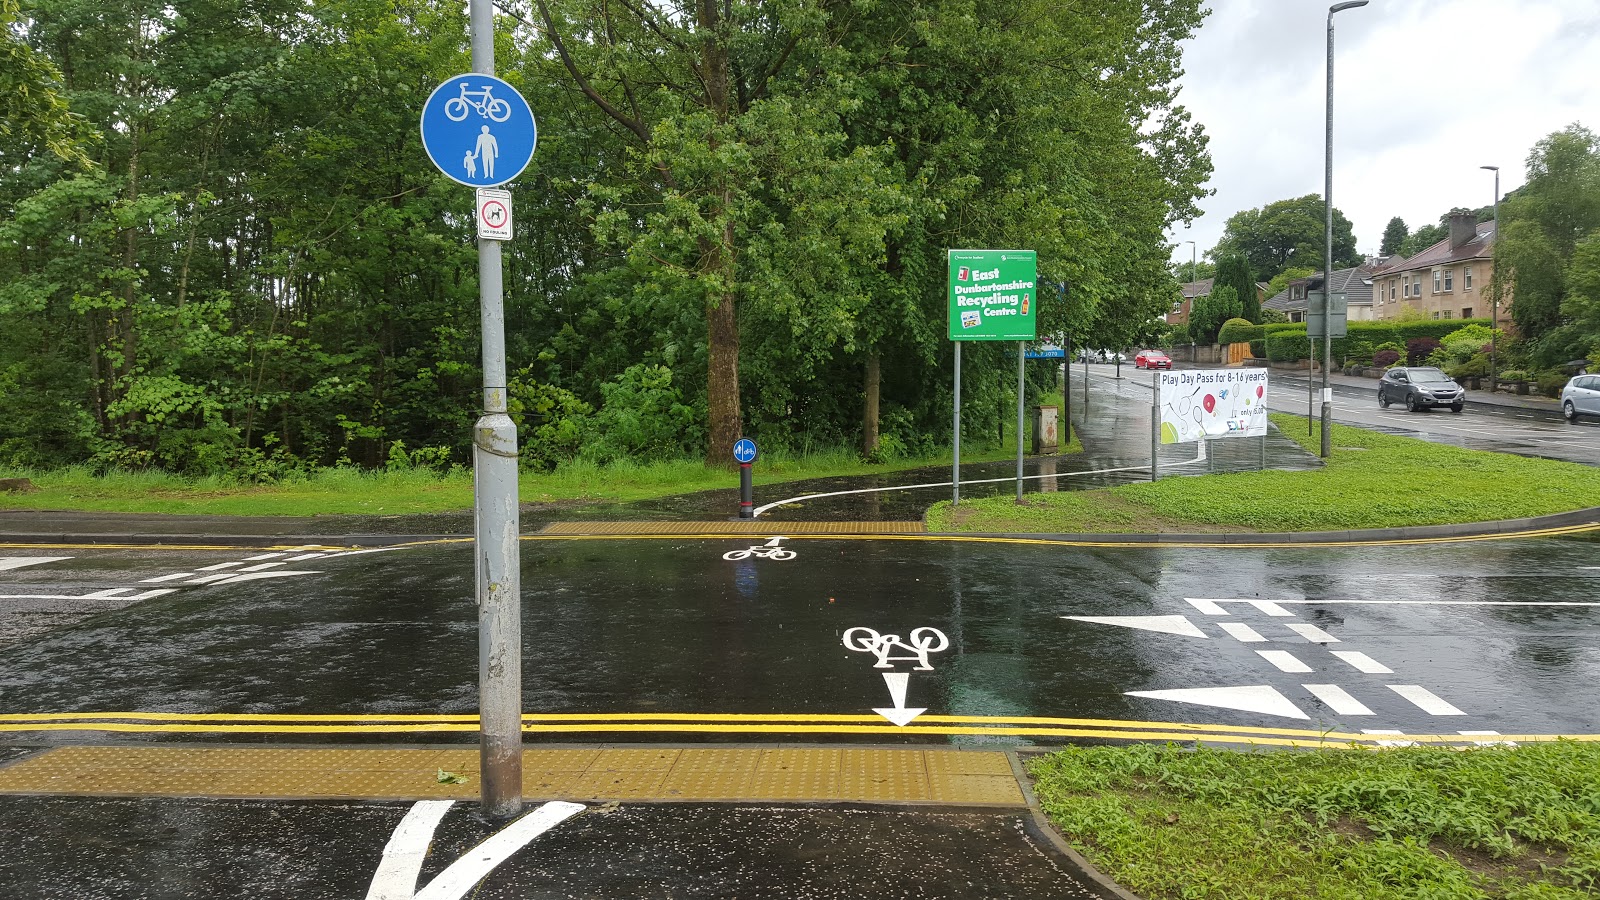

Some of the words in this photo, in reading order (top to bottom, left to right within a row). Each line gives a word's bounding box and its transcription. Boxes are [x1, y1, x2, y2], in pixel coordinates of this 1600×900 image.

[972, 268, 999, 281] East
[955, 280, 1033, 294] Dunbartonshire
[957, 292, 1018, 307] Recycling
[984, 308, 1016, 316] Centre
[1162, 374, 1178, 386] Play
[1181, 373, 1194, 385] Day
[1196, 373, 1214, 383] Pass
[1216, 373, 1226, 382] for
[1227, 372, 1243, 382] 8-16
[1244, 372, 1265, 383] years
